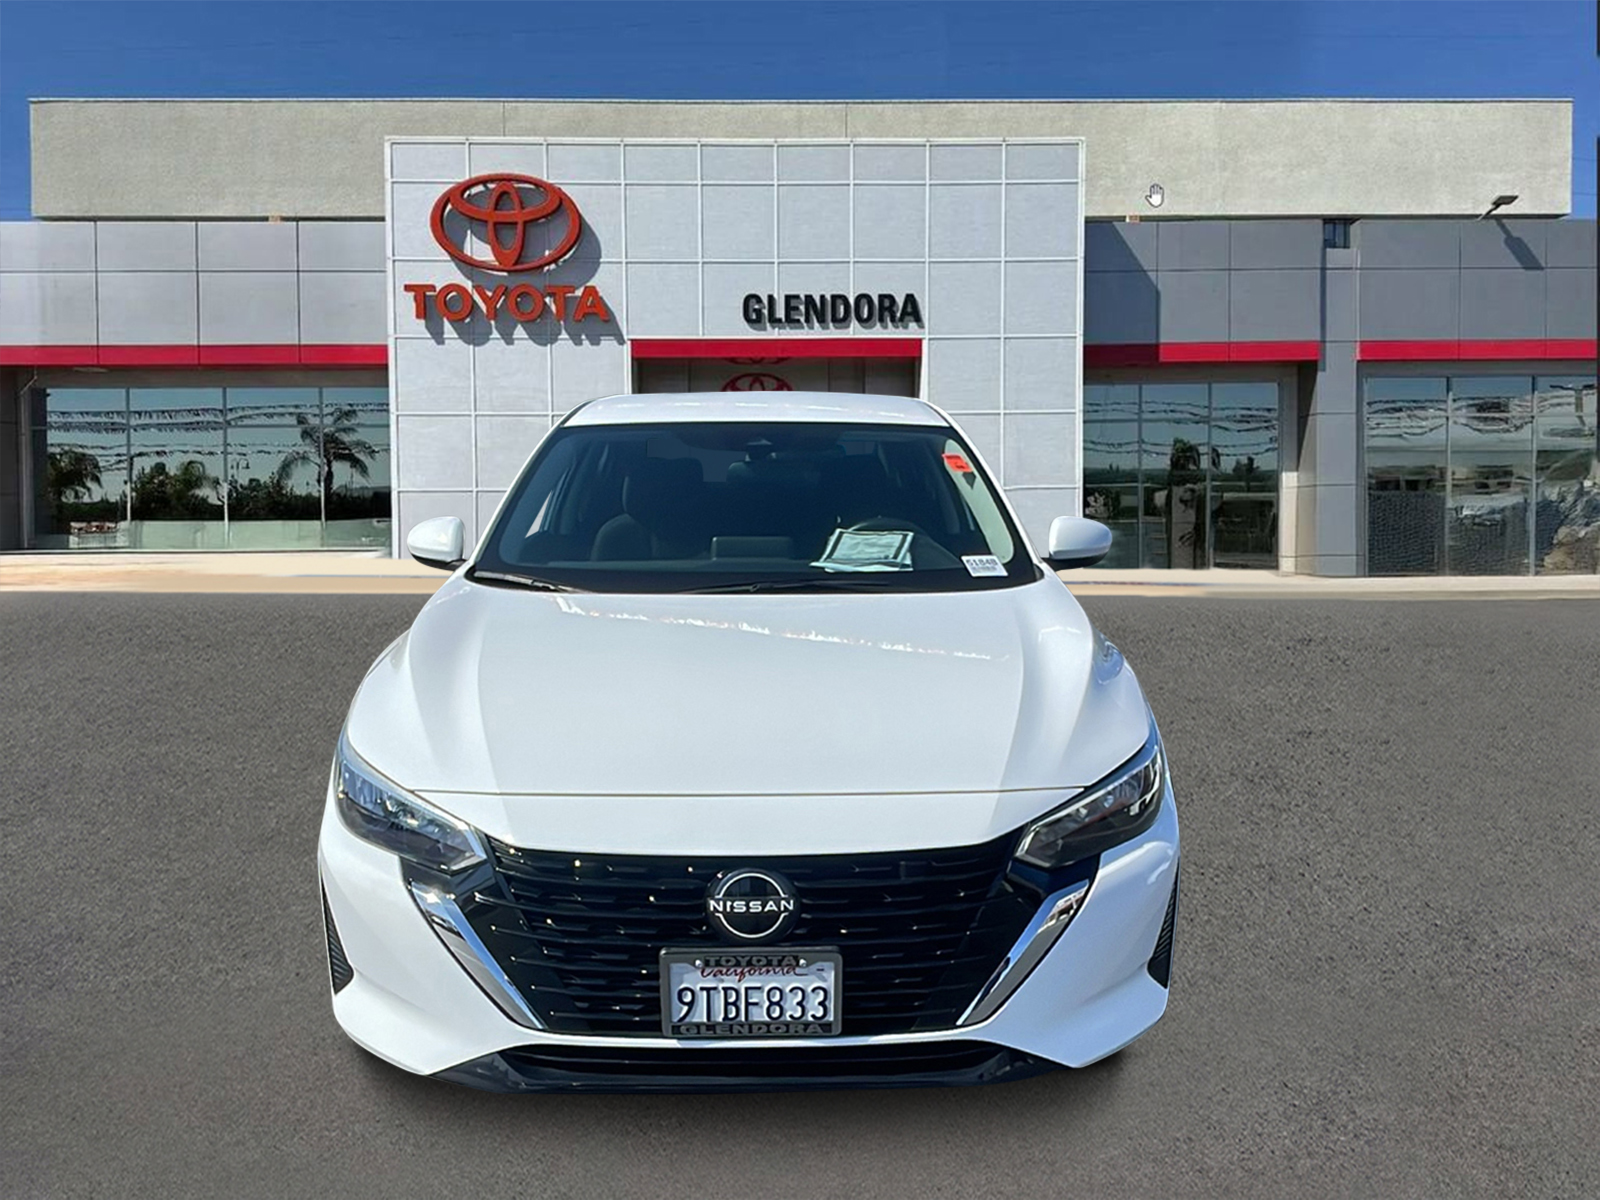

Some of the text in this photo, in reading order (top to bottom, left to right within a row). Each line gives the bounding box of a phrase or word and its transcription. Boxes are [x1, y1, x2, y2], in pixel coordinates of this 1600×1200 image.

[404, 283, 610, 323] TOYOTA
[742, 293, 923, 326] GLENDORA
[709, 899, 794, 913] NISSAN
[705, 956, 797, 967] TOYOTA
[677, 986, 828, 1022] 9TBF833
[680, 1023, 824, 1034] GLENDORA
